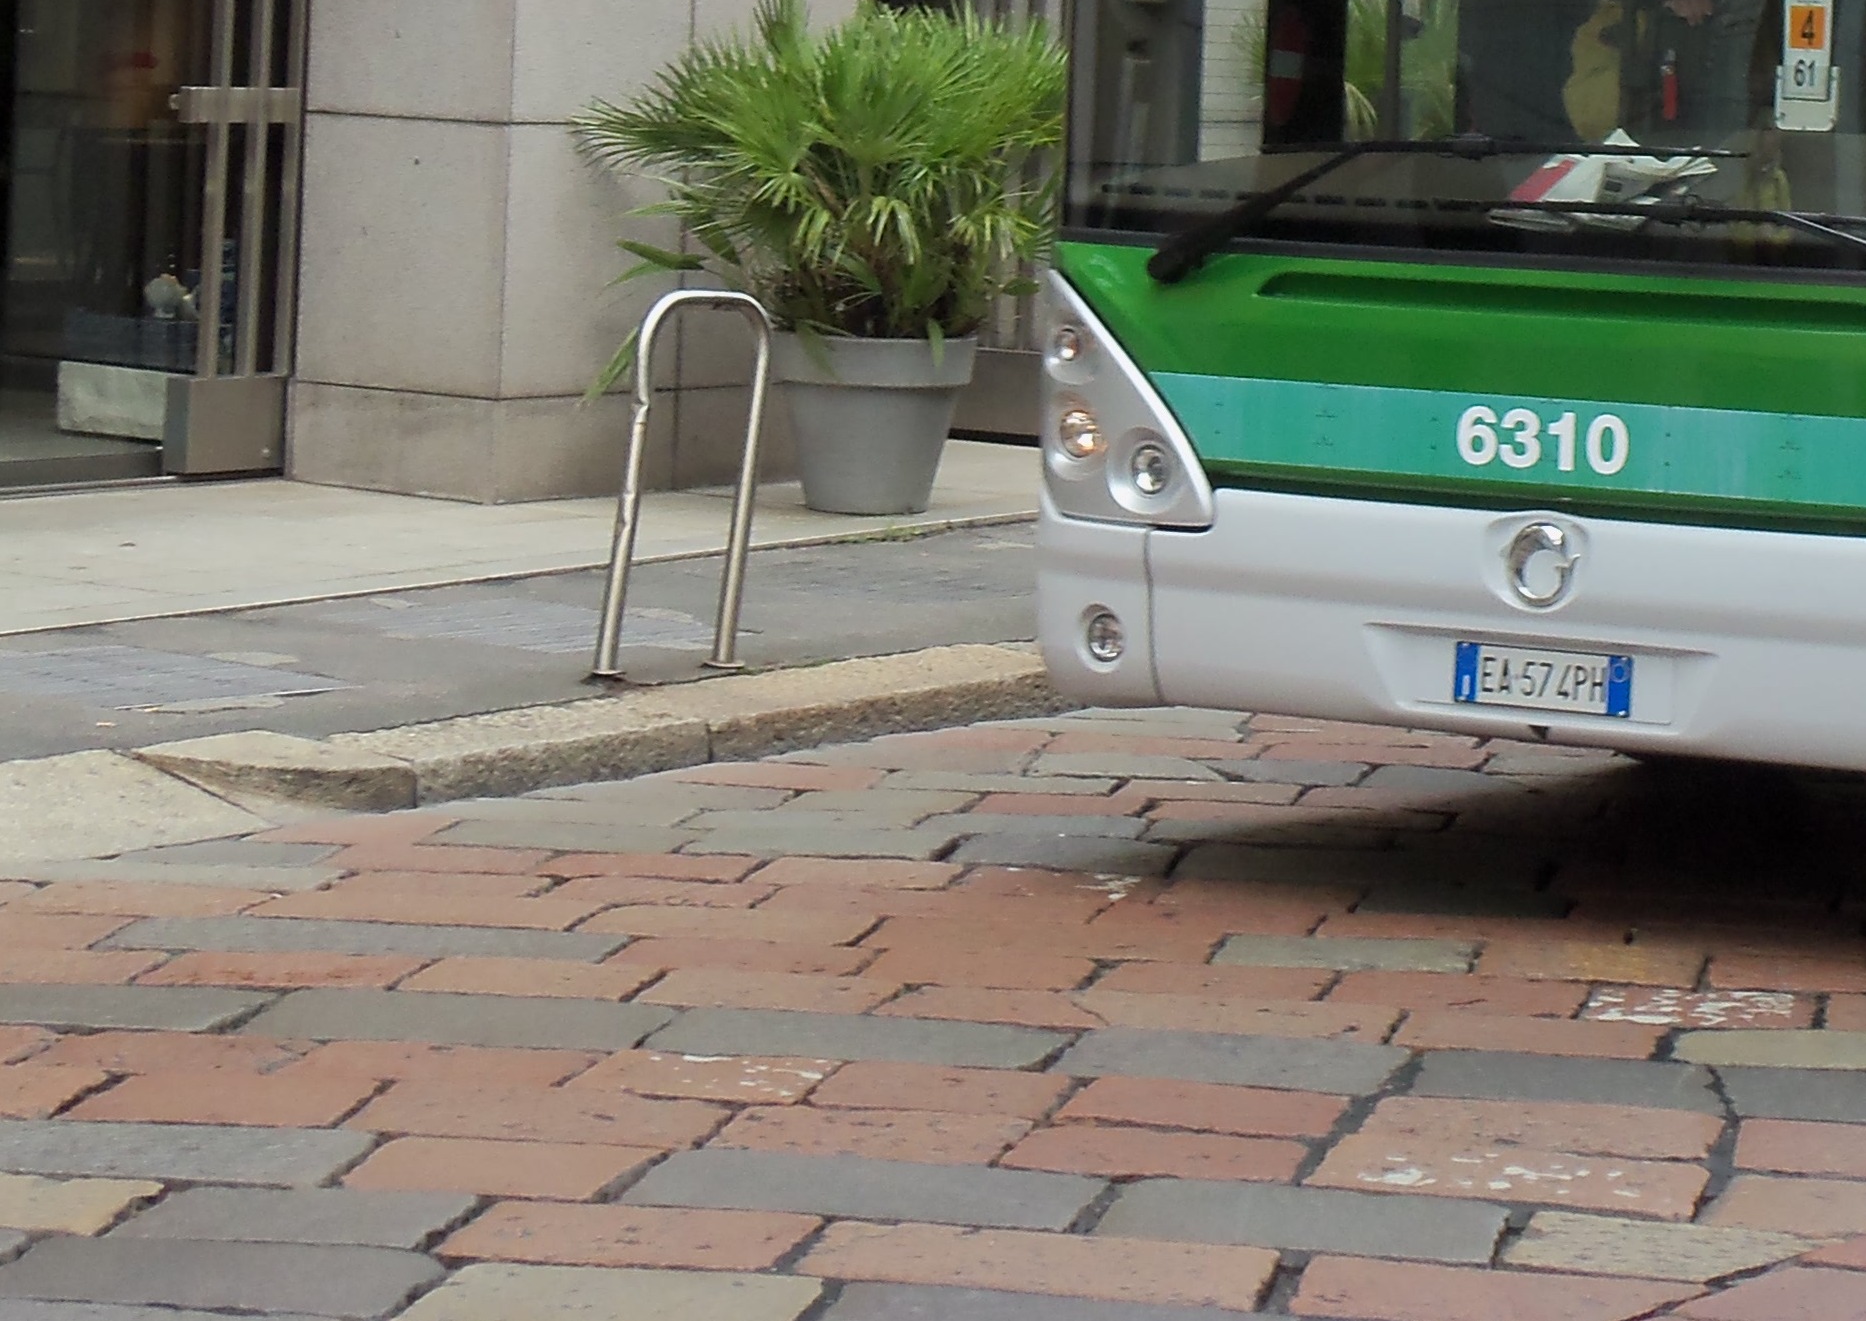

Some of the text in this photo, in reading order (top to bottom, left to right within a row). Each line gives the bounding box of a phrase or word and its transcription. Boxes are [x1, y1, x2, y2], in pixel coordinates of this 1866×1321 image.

[1801, 10, 1815, 46] 4
[1794, 59, 1816, 87] 61
[1456, 405, 1630, 475] 6310
